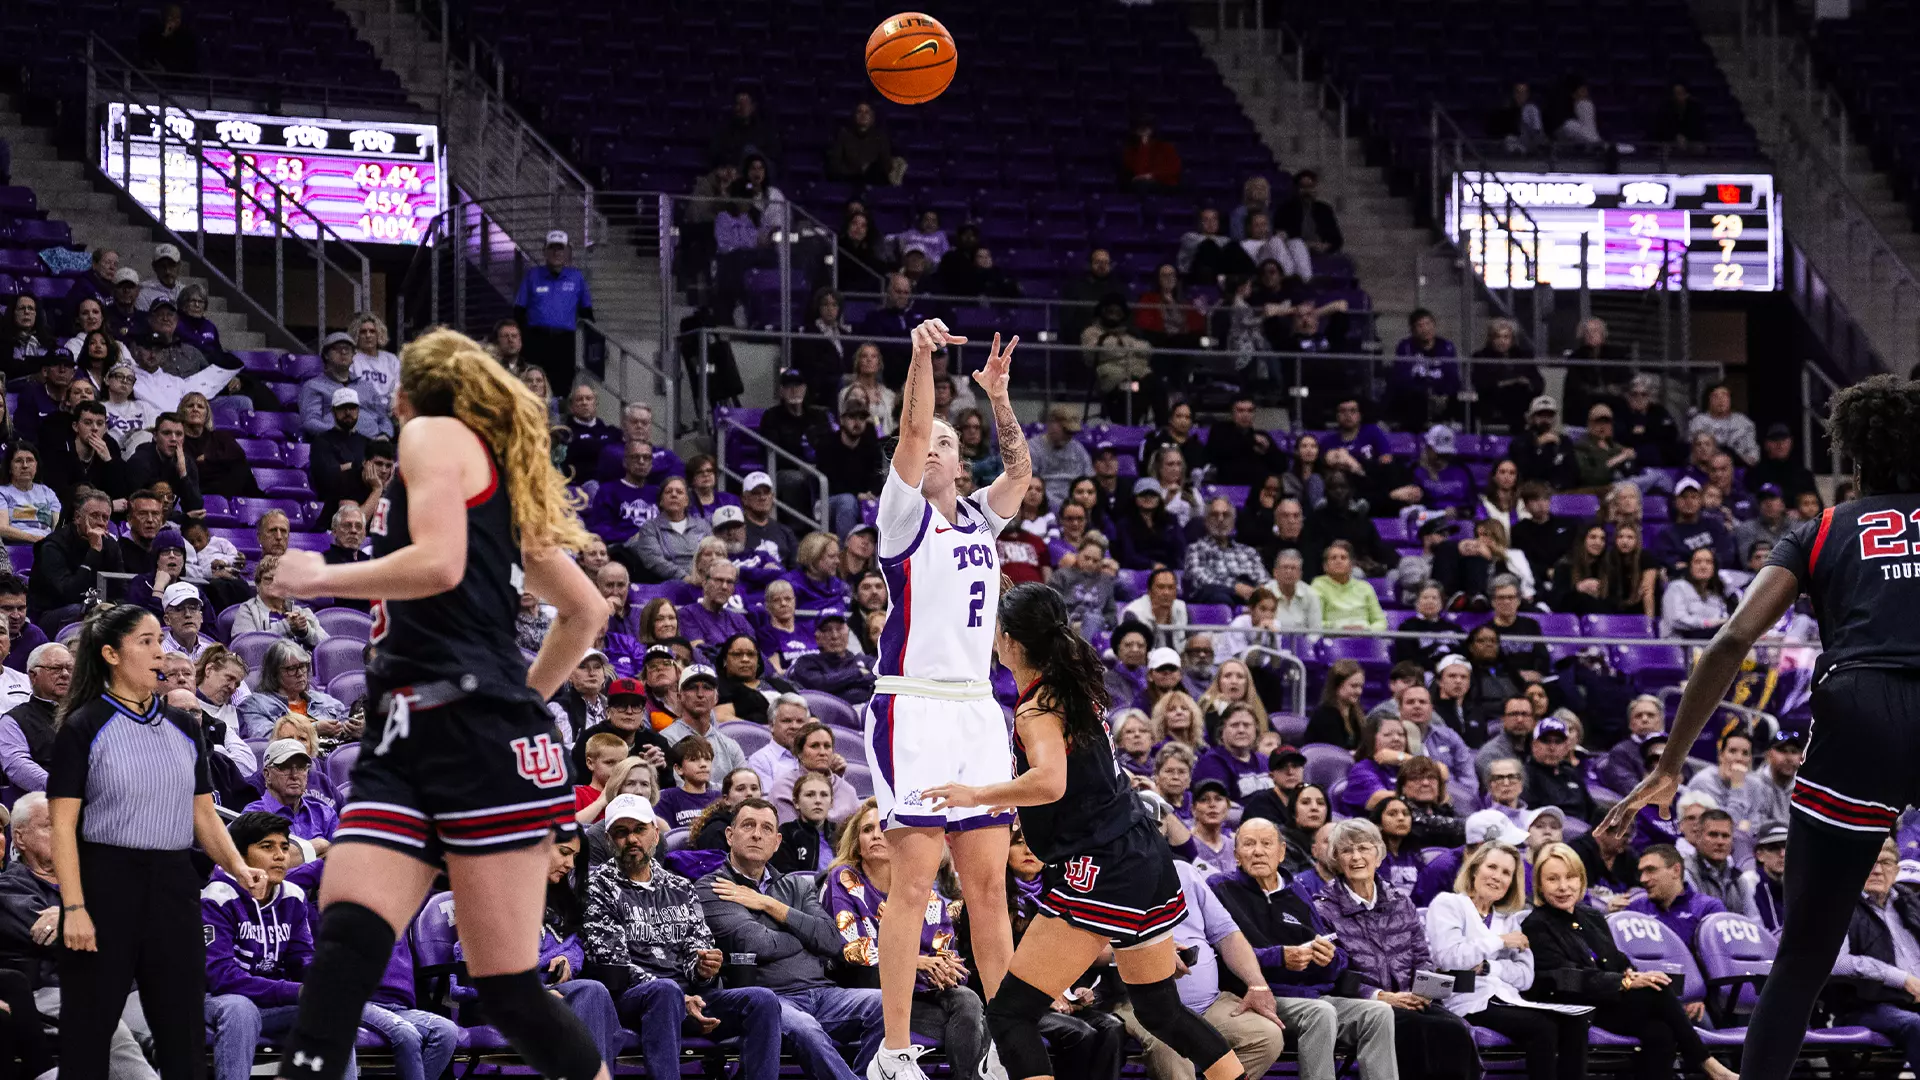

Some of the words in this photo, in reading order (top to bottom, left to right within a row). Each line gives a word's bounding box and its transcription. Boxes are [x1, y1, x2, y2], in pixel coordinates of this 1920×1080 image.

[276, 157, 303, 181] 53
[353, 163, 421, 190] 43.4%
[364, 190, 413, 216] 45%
[357, 214, 420, 242] 100%
[1711, 214, 1743, 238] 29
[1718, 239, 1736, 263] 7
[1713, 263, 1744, 287] 22
[362, 370, 387, 384] TCU
[953, 544, 993, 571] TCU
[967, 580, 986, 627] 2
[797, 847, 808, 860] 12
[1616, 917, 1664, 943] TCU
[1715, 919, 1762, 944] TCU
